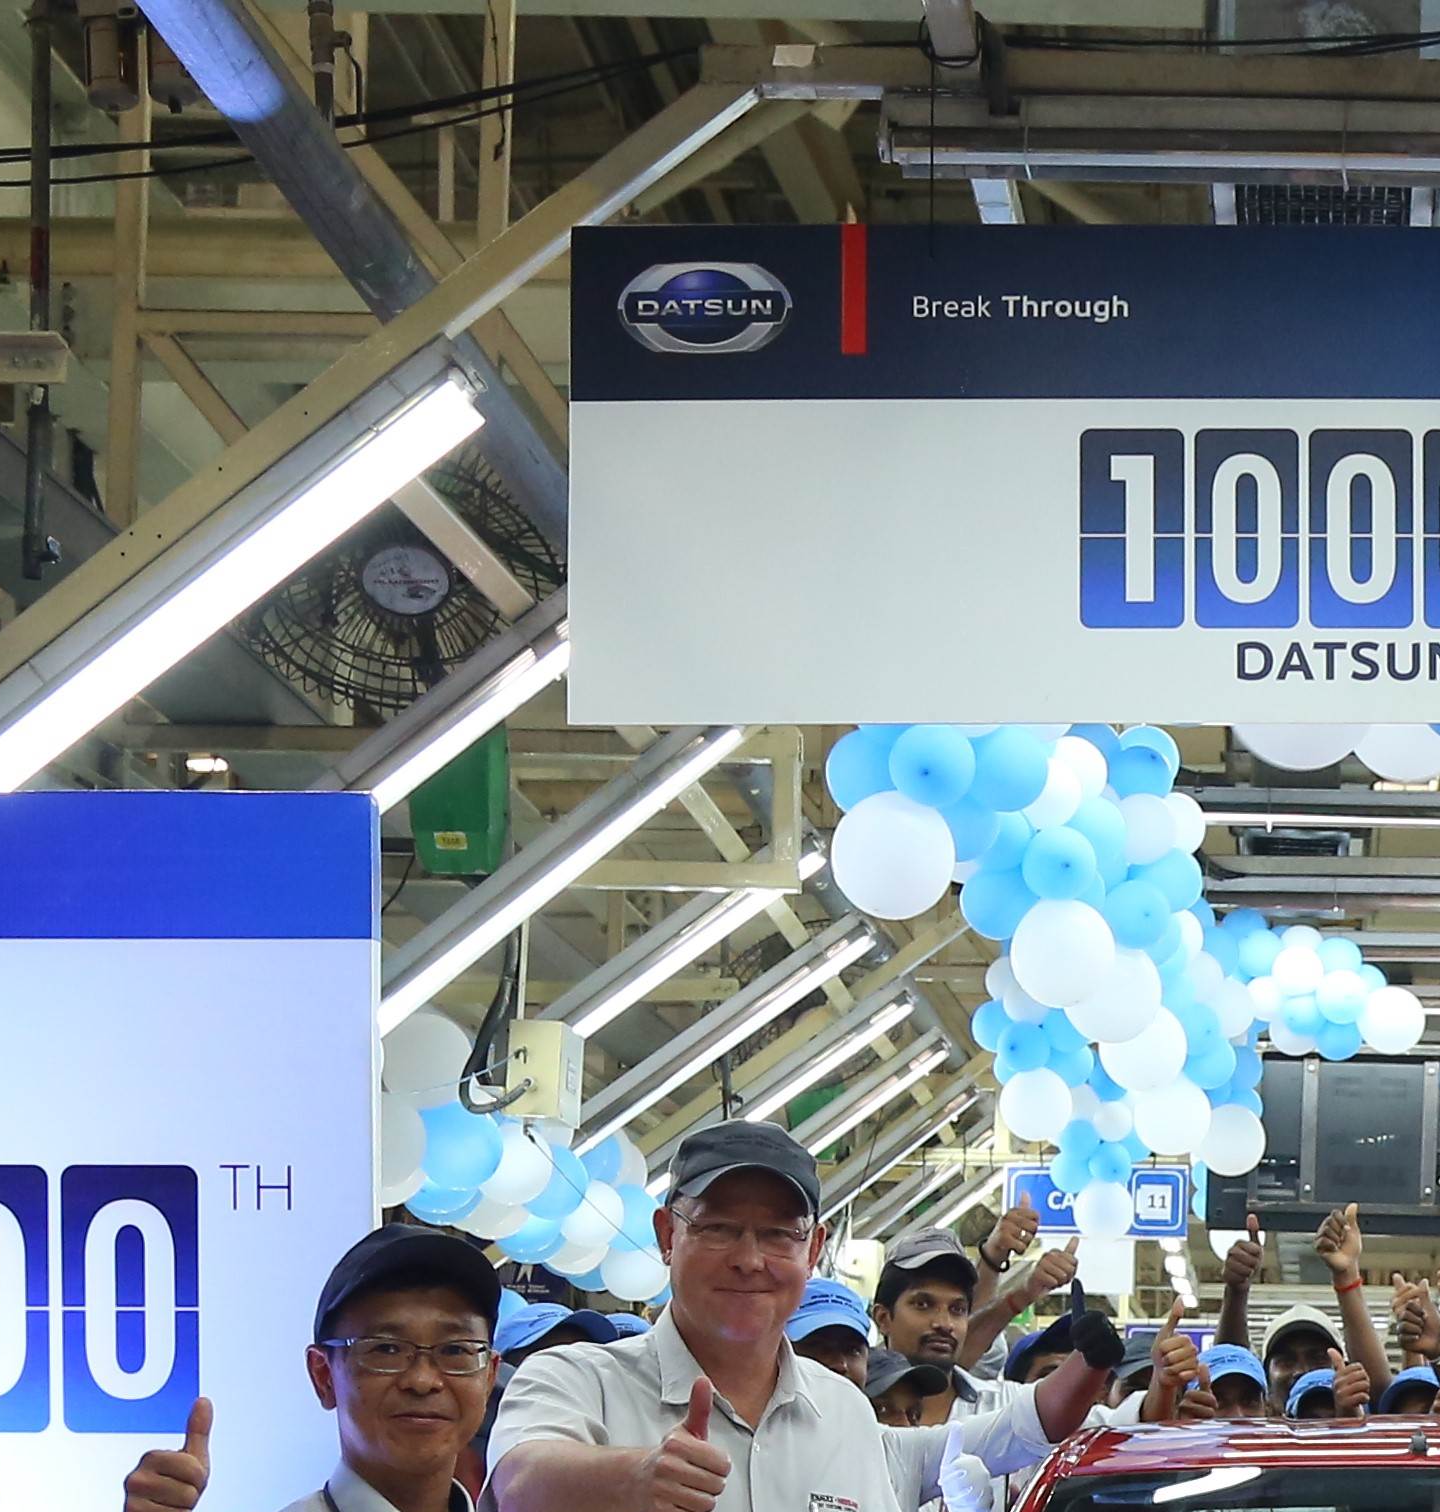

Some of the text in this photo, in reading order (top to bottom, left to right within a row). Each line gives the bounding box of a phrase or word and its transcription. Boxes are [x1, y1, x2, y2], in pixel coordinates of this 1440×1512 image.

[637, 298, 773, 316] DATSUN
[912, 294, 1130, 323] Break Through
[219, 1164, 292, 1212] TH
[1147, 1194, 1167, 1209] 11
